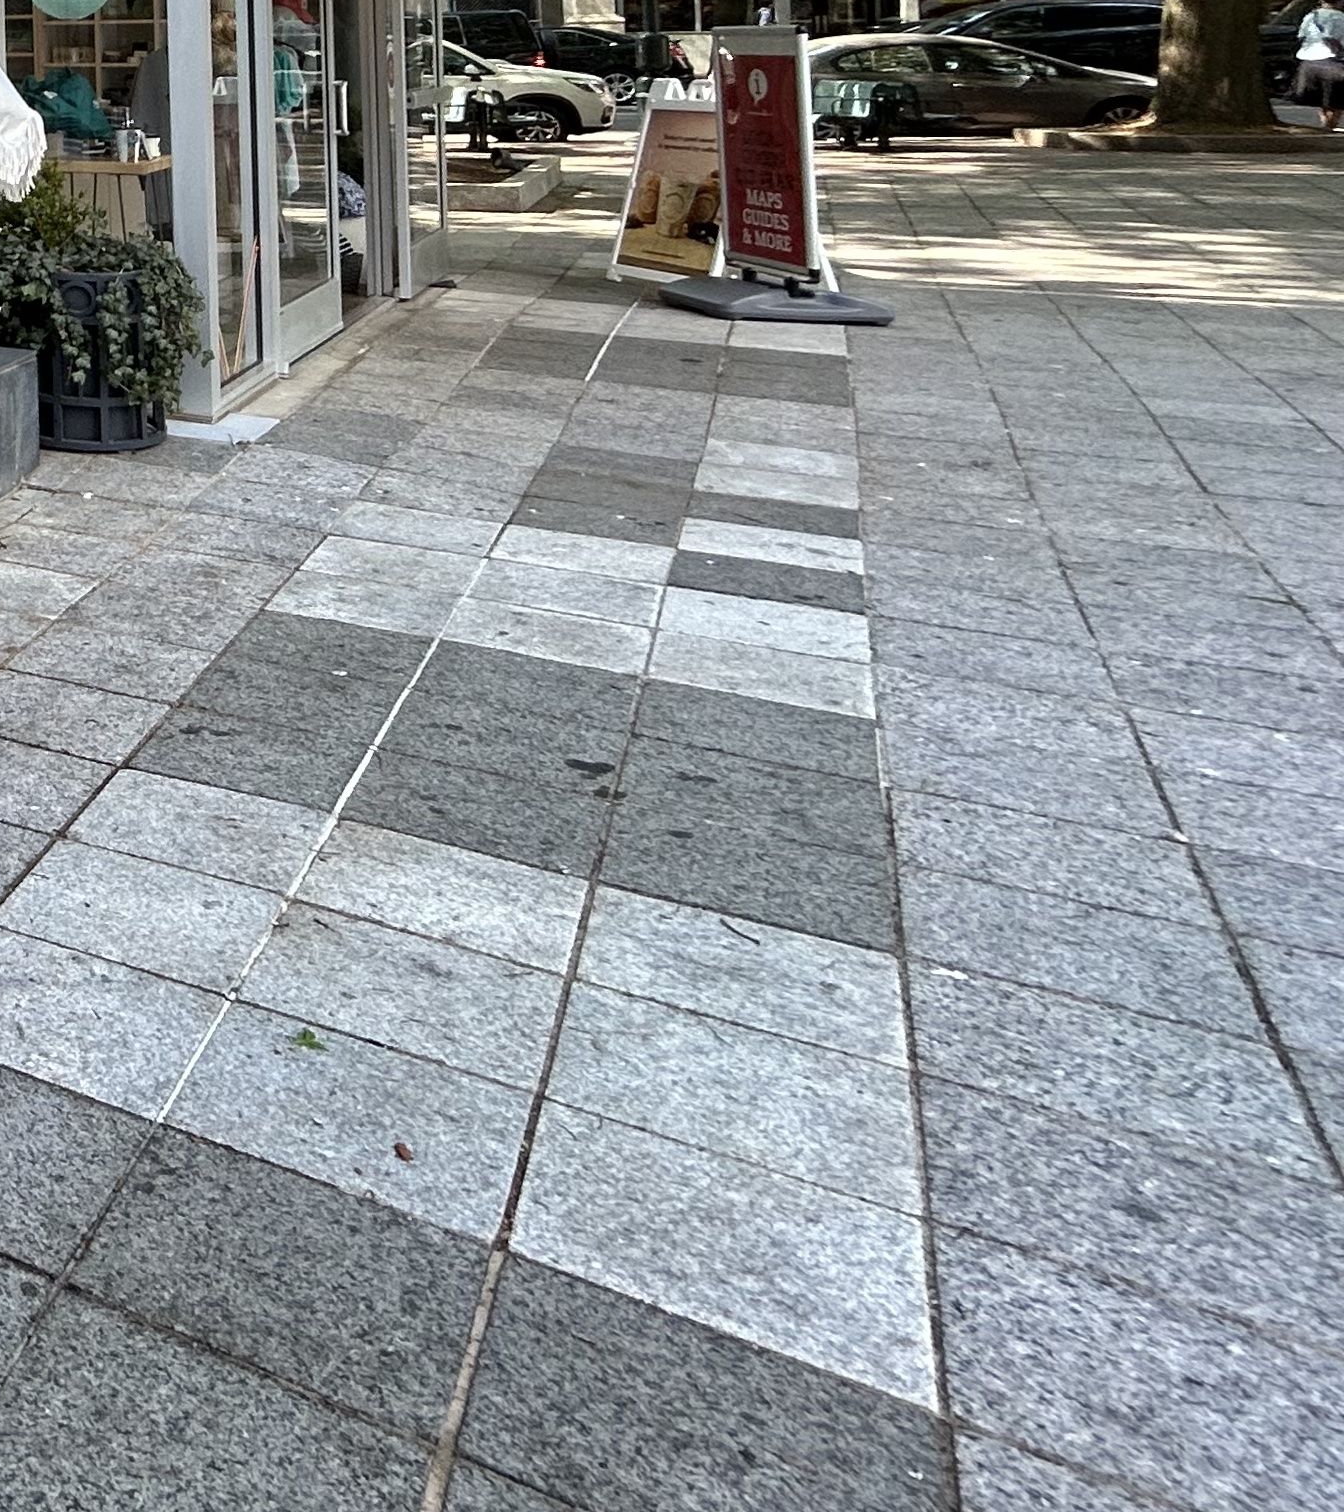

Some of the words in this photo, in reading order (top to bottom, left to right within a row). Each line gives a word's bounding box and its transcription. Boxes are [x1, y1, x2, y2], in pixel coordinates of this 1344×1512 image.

[746, 188, 783, 209] MAPS
[742, 208, 790, 231] GUIDES
[743, 228, 752, 245] &
[754, 230, 793, 253] MORE
